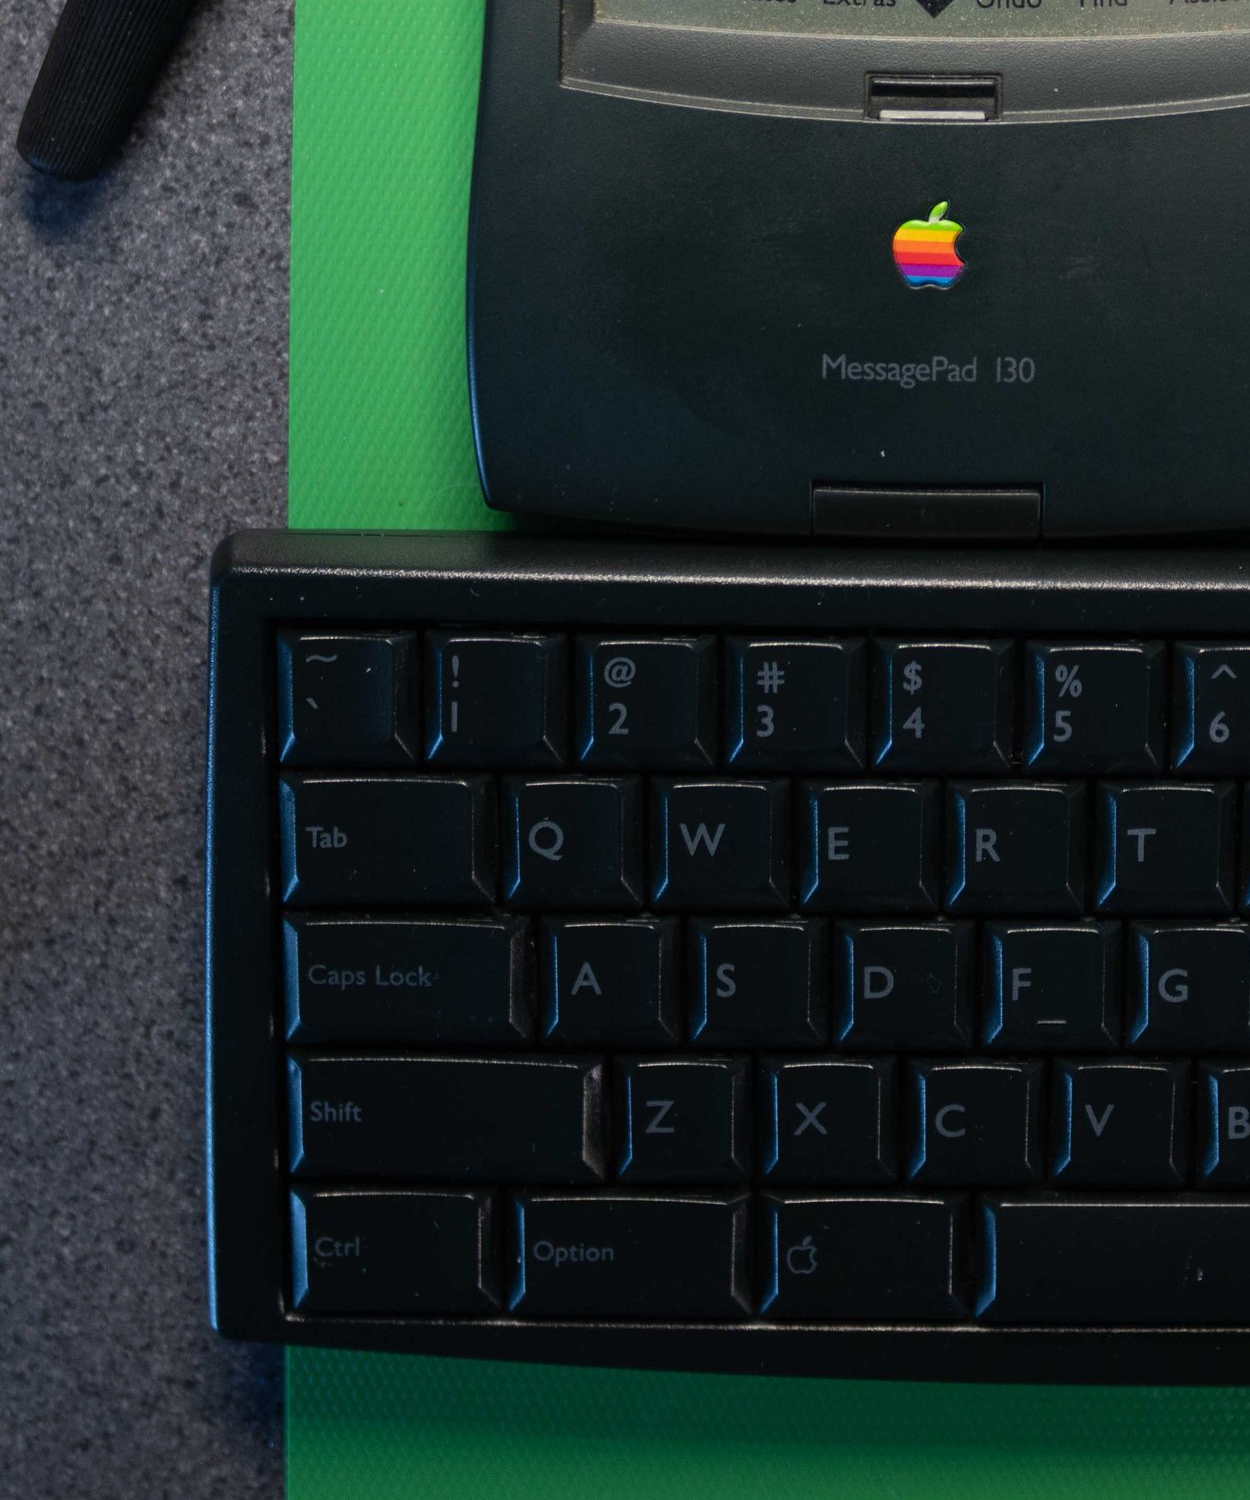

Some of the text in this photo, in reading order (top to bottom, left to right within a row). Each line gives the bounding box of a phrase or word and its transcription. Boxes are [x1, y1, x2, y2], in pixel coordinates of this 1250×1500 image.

[822, 354, 1036, 389] MessagePad 130
[604, 658, 636, 688] @
[757, 662, 785, 693] #
[903, 661, 922, 694] $
[1055, 665, 1083, 698] %
[608, 703, 630, 735] 2
[756, 706, 775, 737] 3
[902, 708, 925, 738] 4
[1053, 711, 1073, 742] 5
[1209, 712, 1230, 743] 6
[306, 827, 348, 849] Tab
[528, 820, 564, 861] Q
[680, 823, 725, 856] W
[828, 827, 849, 860] E
[976, 829, 1000, 862] R
[1127, 829, 1156, 862] T
[308, 965, 431, 988] Caps Lock
[570, 964, 601, 995] A
[716, 964, 736, 998] S
[864, 968, 894, 999] D
[1011, 968, 1032, 1000] F
[1159, 969, 1189, 1002] G
[310, 1102, 362, 1123] Shift
[646, 1101, 674, 1133] Z
[794, 1102, 827, 1136] X
[935, 1104, 966, 1138] C
[1085, 1105, 1115, 1136] V
[1228, 1107, 1250, 1139] B
[315, 1237, 360, 1258] Ctrl
[533, 1242, 615, 1266] Option
